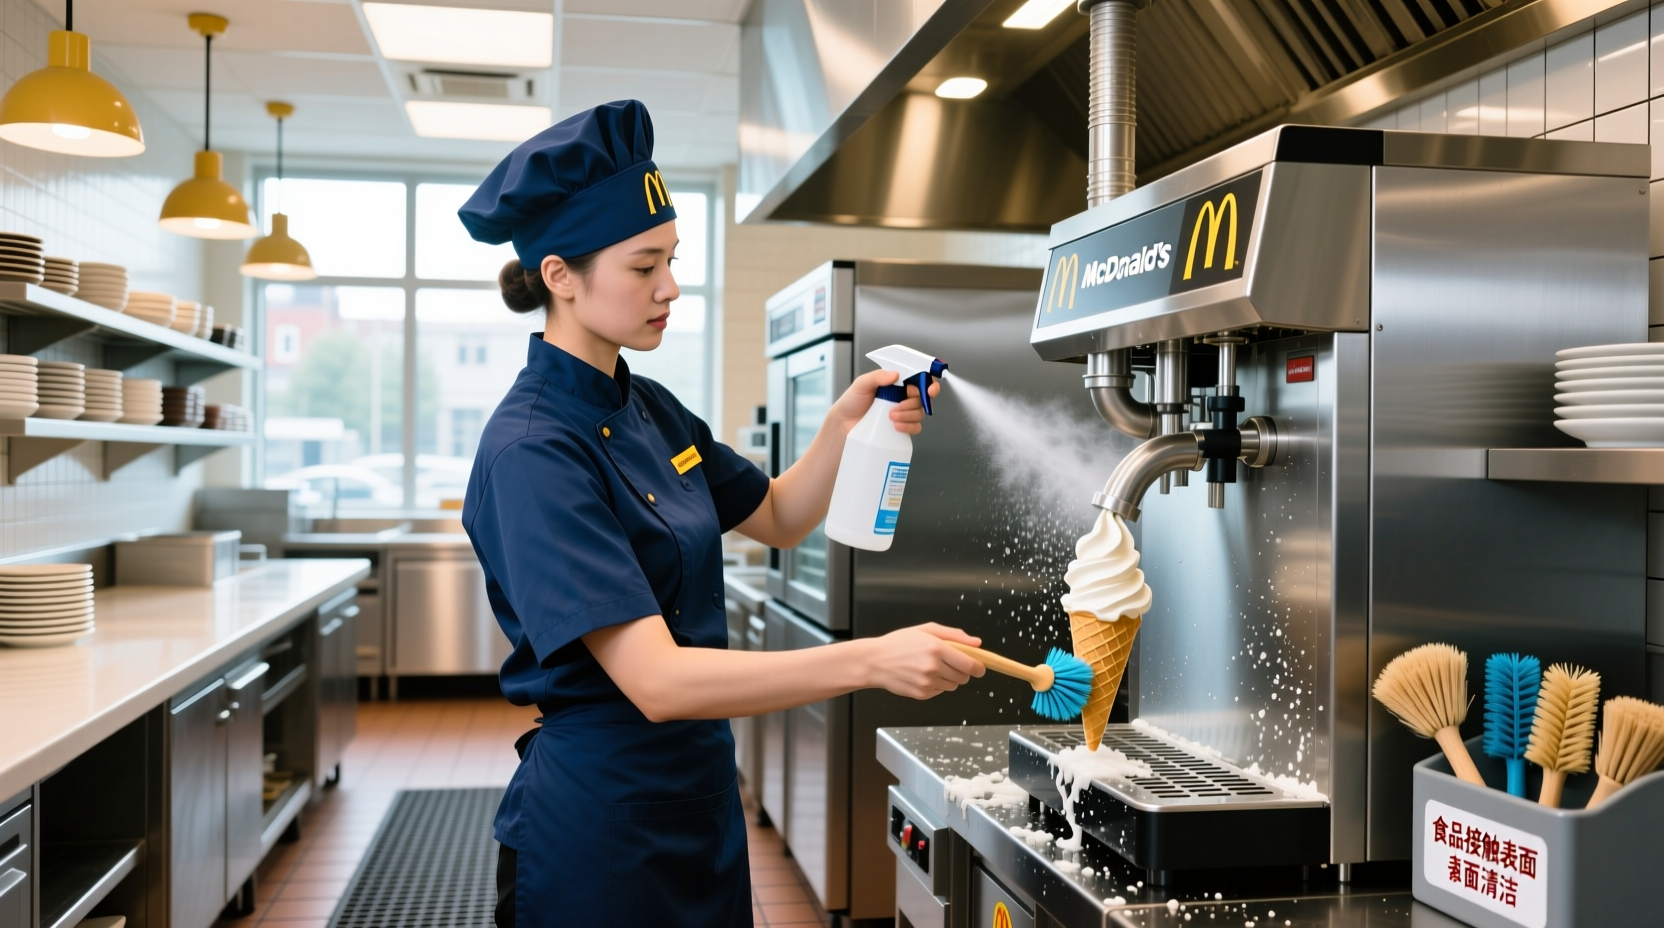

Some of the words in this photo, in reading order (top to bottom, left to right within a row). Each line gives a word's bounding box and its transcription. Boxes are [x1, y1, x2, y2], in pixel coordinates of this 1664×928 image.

[1432, 815, 1538, 880] 食品接触表面
